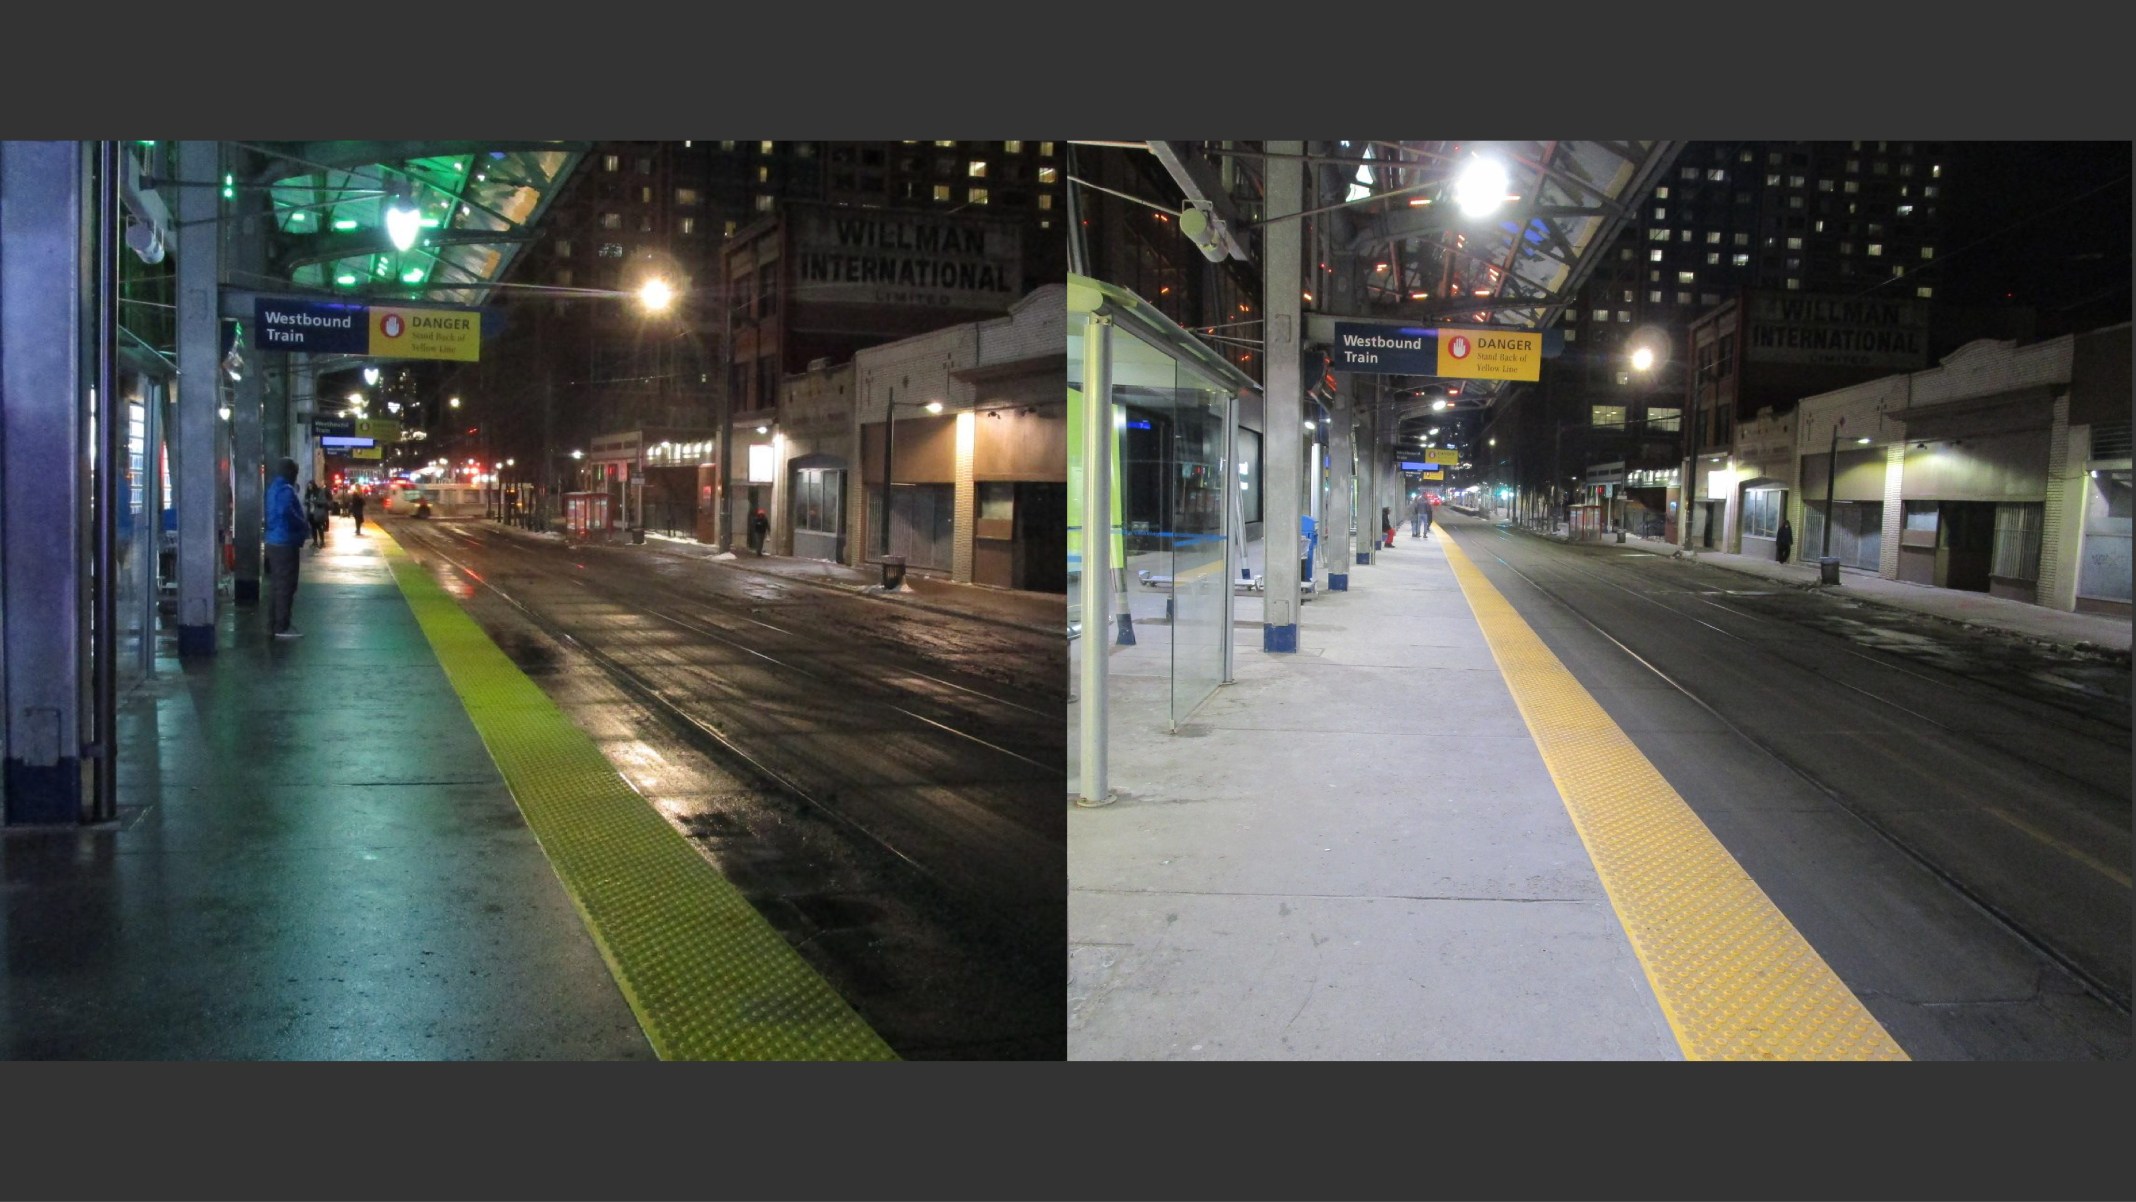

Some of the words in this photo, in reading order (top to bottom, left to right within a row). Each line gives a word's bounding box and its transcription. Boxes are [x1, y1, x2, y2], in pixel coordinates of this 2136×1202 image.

[836, 217, 985, 256] WILLMAN
[800, 253, 1012, 293] INTERNATIONAL
[1783, 298, 1900, 324] WILLMAN
[265, 311, 351, 328] Westbound
[412, 316, 470, 330] DANGER
[266, 328, 304, 343] Train
[1343, 335, 1421, 350] Westbound
[1753, 326, 1920, 354] INTERNATIONAL
[1478, 338, 1532, 351] DANGER
[1344, 351, 1378, 364] Train
[1477, 352, 1498, 362] Stand
[1499, 353, 1518, 362] Back
[1519, 354, 1527, 362] of
[1476, 363, 1500, 373] Yellow
[1502, 365, 1518, 373] Line
